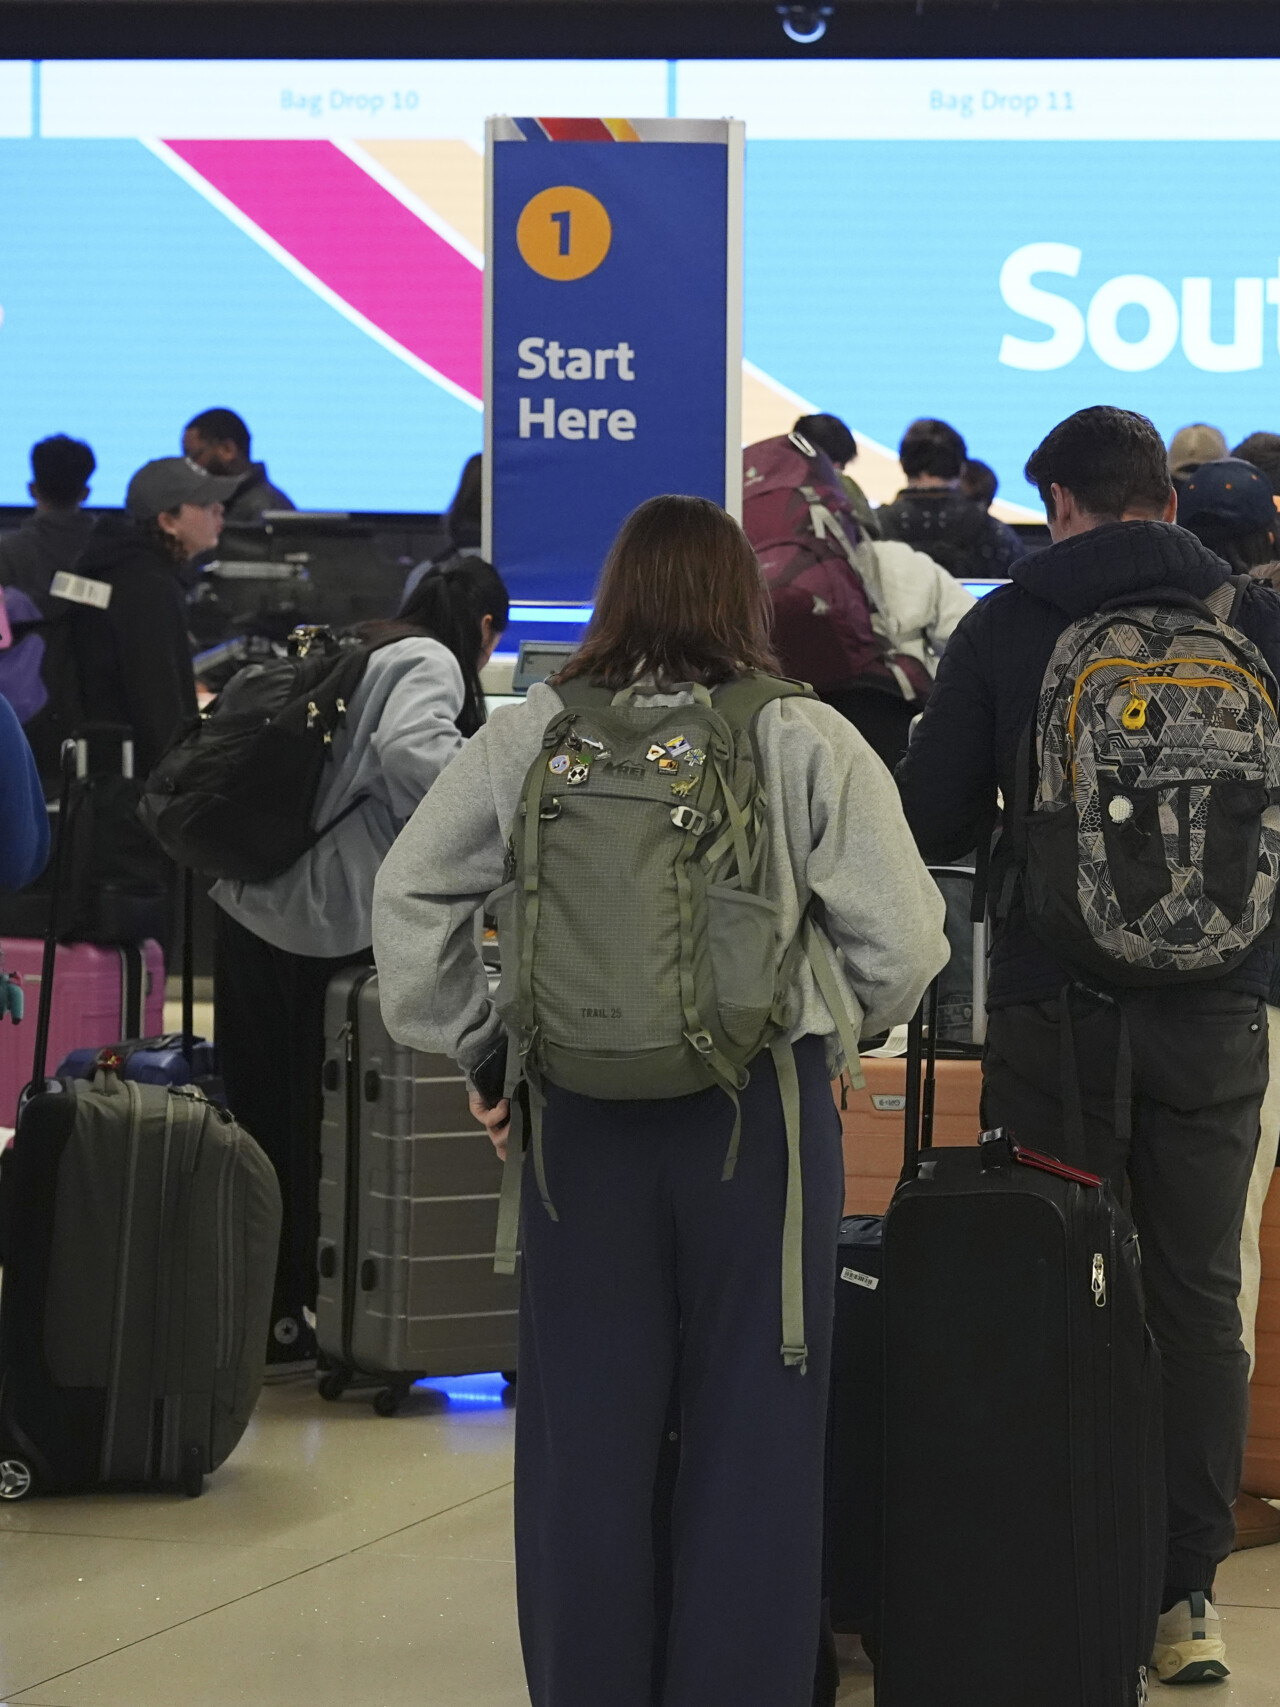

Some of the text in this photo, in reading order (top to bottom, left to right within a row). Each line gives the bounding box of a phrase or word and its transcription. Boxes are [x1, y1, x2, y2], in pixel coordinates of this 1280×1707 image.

[280, 89, 419, 117] Bag Drop 10
[929, 89, 1073, 118] Bag Drop 11
[550, 210, 571, 256] 1
[517, 337, 635, 381] Start
[519, 397, 637, 441] Here
[581, 1007, 623, 1019] TRAIL 25
